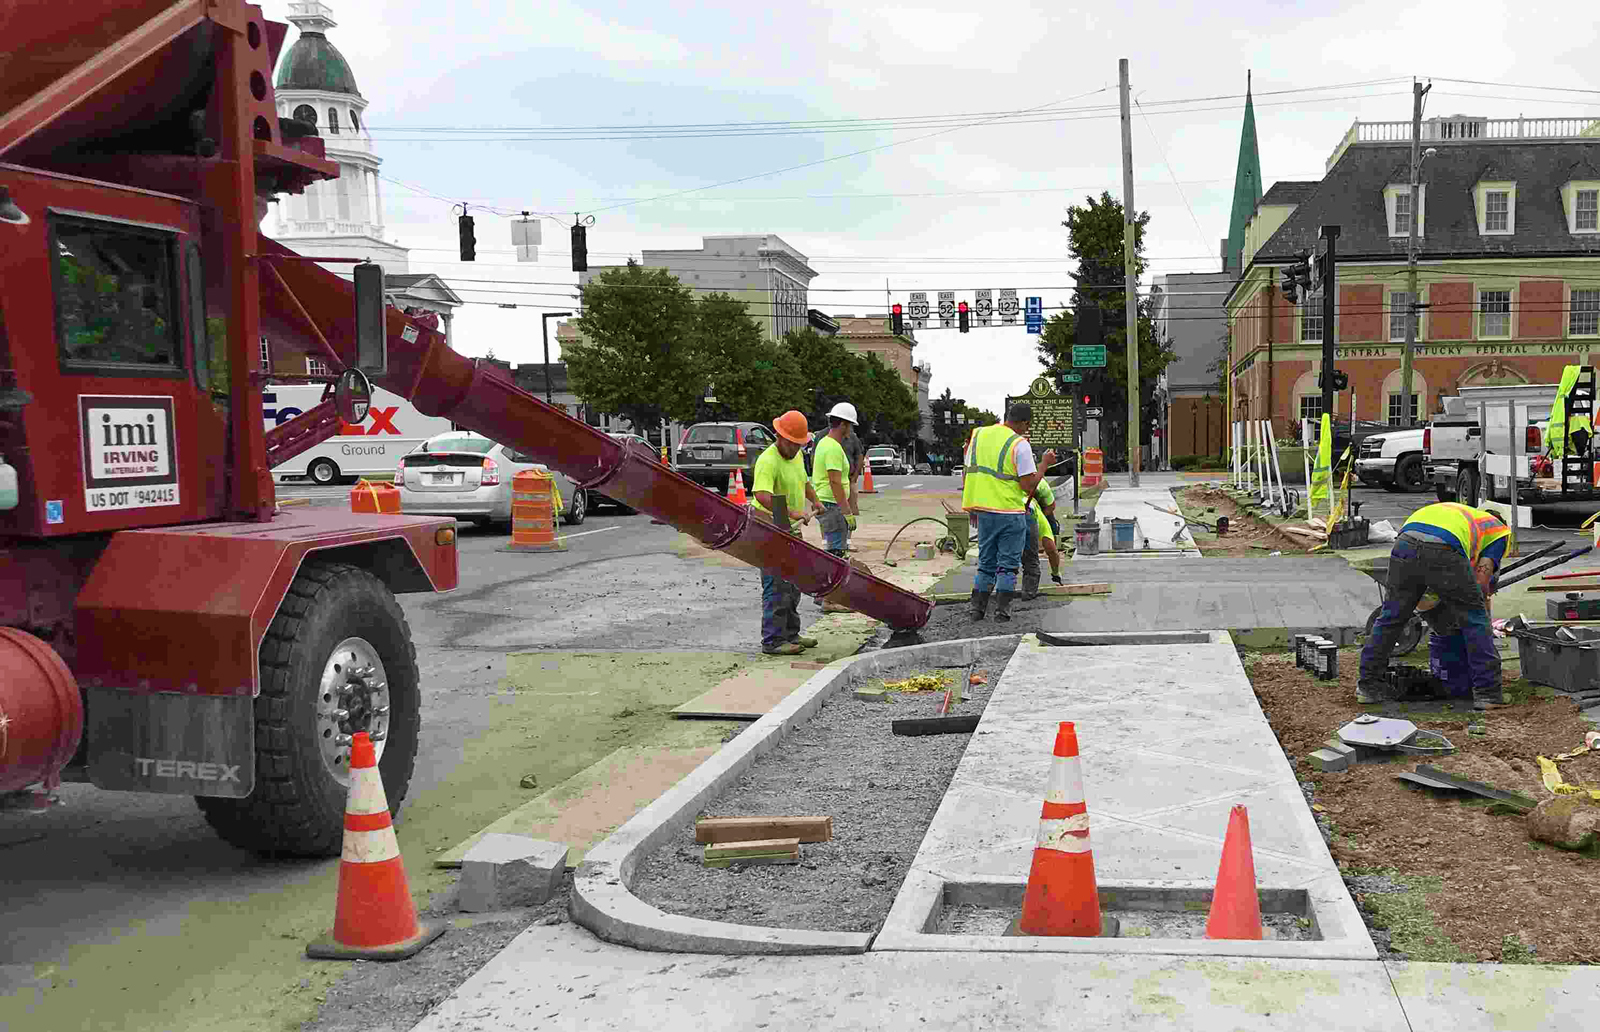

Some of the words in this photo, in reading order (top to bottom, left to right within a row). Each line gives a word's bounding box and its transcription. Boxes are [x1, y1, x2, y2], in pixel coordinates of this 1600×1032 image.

[910, 305, 928, 315] 150
[940, 304, 953, 314] 52
[977, 303, 990, 313] 34
[1001, 301, 1016, 312] 127
[1335, 348, 1387, 357] CENTRAL
[1476, 345, 1528, 355] FEDERAL
[1541, 344, 1591, 354] SAVINGS
[102, 413, 157, 446] imi
[341, 443, 386, 456] Ground
[103, 450, 159, 464] IRVING
[104, 466, 144, 475] MATERIALS
[91, 493, 106, 508] US
[109, 491, 129, 506] DOT
[135, 757, 241, 783] TEREX
